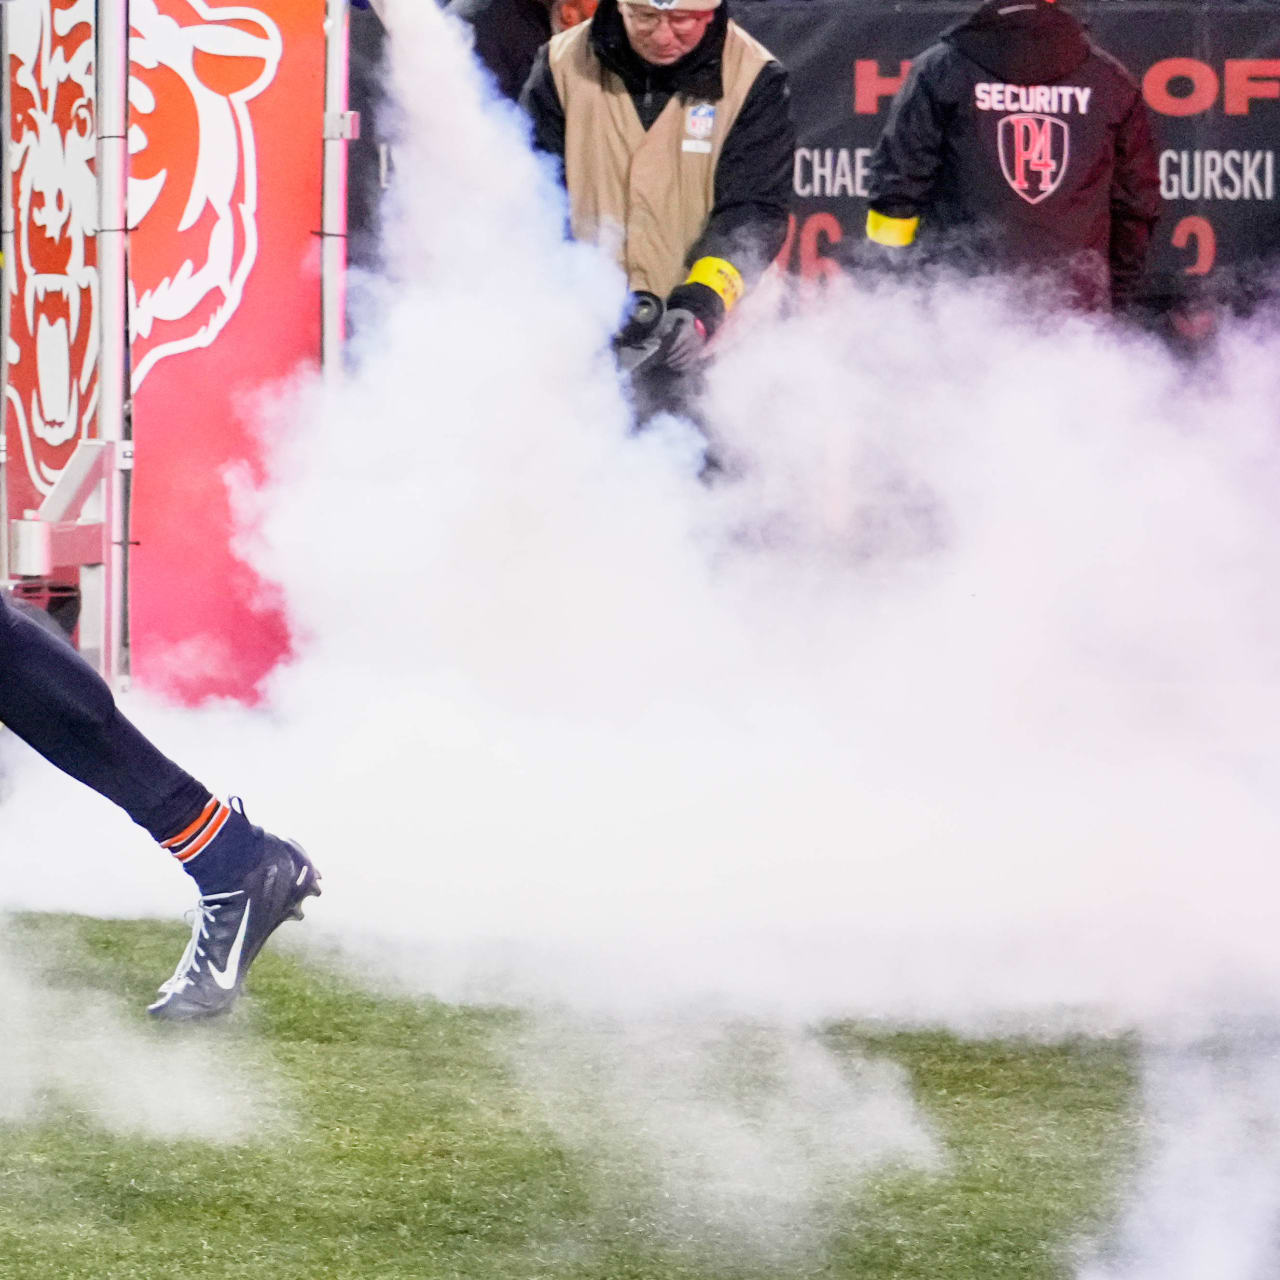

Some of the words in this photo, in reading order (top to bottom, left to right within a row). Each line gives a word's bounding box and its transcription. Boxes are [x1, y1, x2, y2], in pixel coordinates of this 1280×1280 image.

[974, 82, 1092, 115] SECURITY
[1142, 57, 1280, 116] OF
[793, 147, 873, 198] CHAE
[1158, 148, 1274, 200] GURSKI
